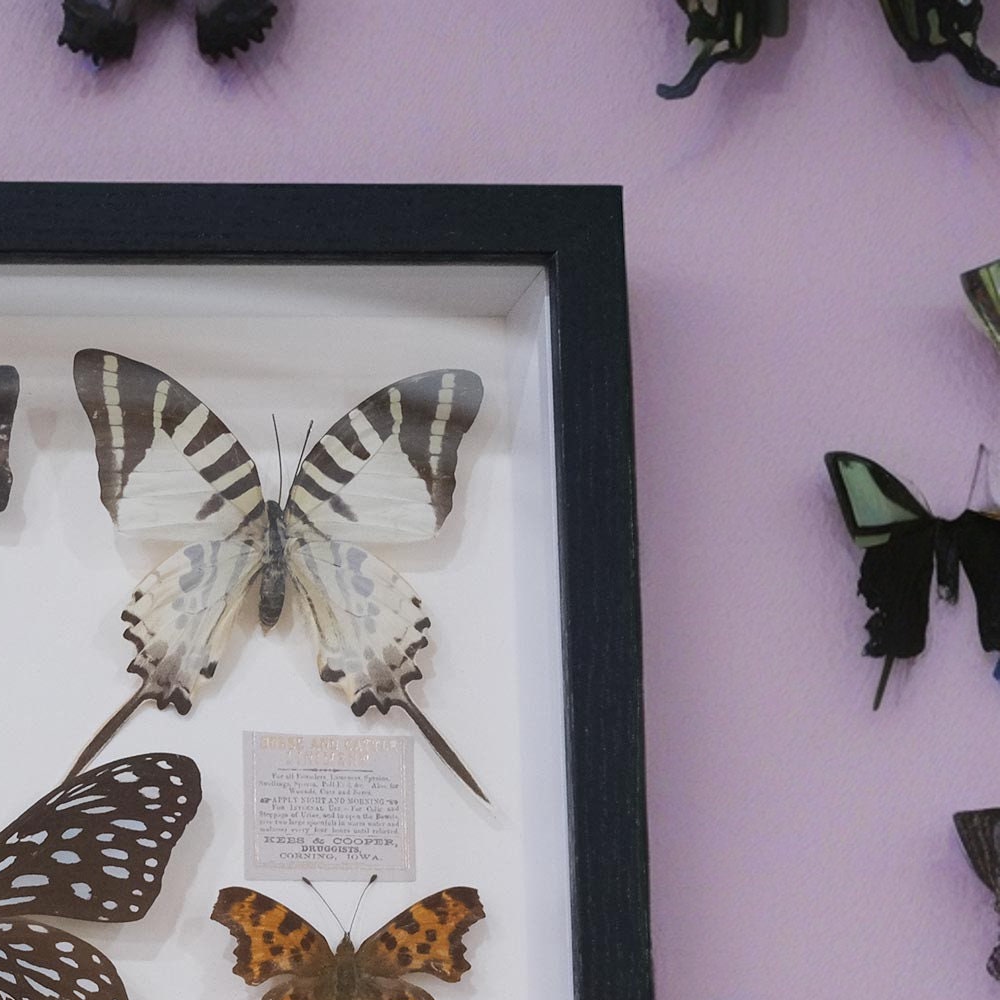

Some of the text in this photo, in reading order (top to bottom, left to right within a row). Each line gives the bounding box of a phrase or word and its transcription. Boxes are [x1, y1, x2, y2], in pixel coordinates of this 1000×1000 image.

[263, 836, 399, 848] KEES & COOPER,
[279, 852, 338, 861] CORNING,
